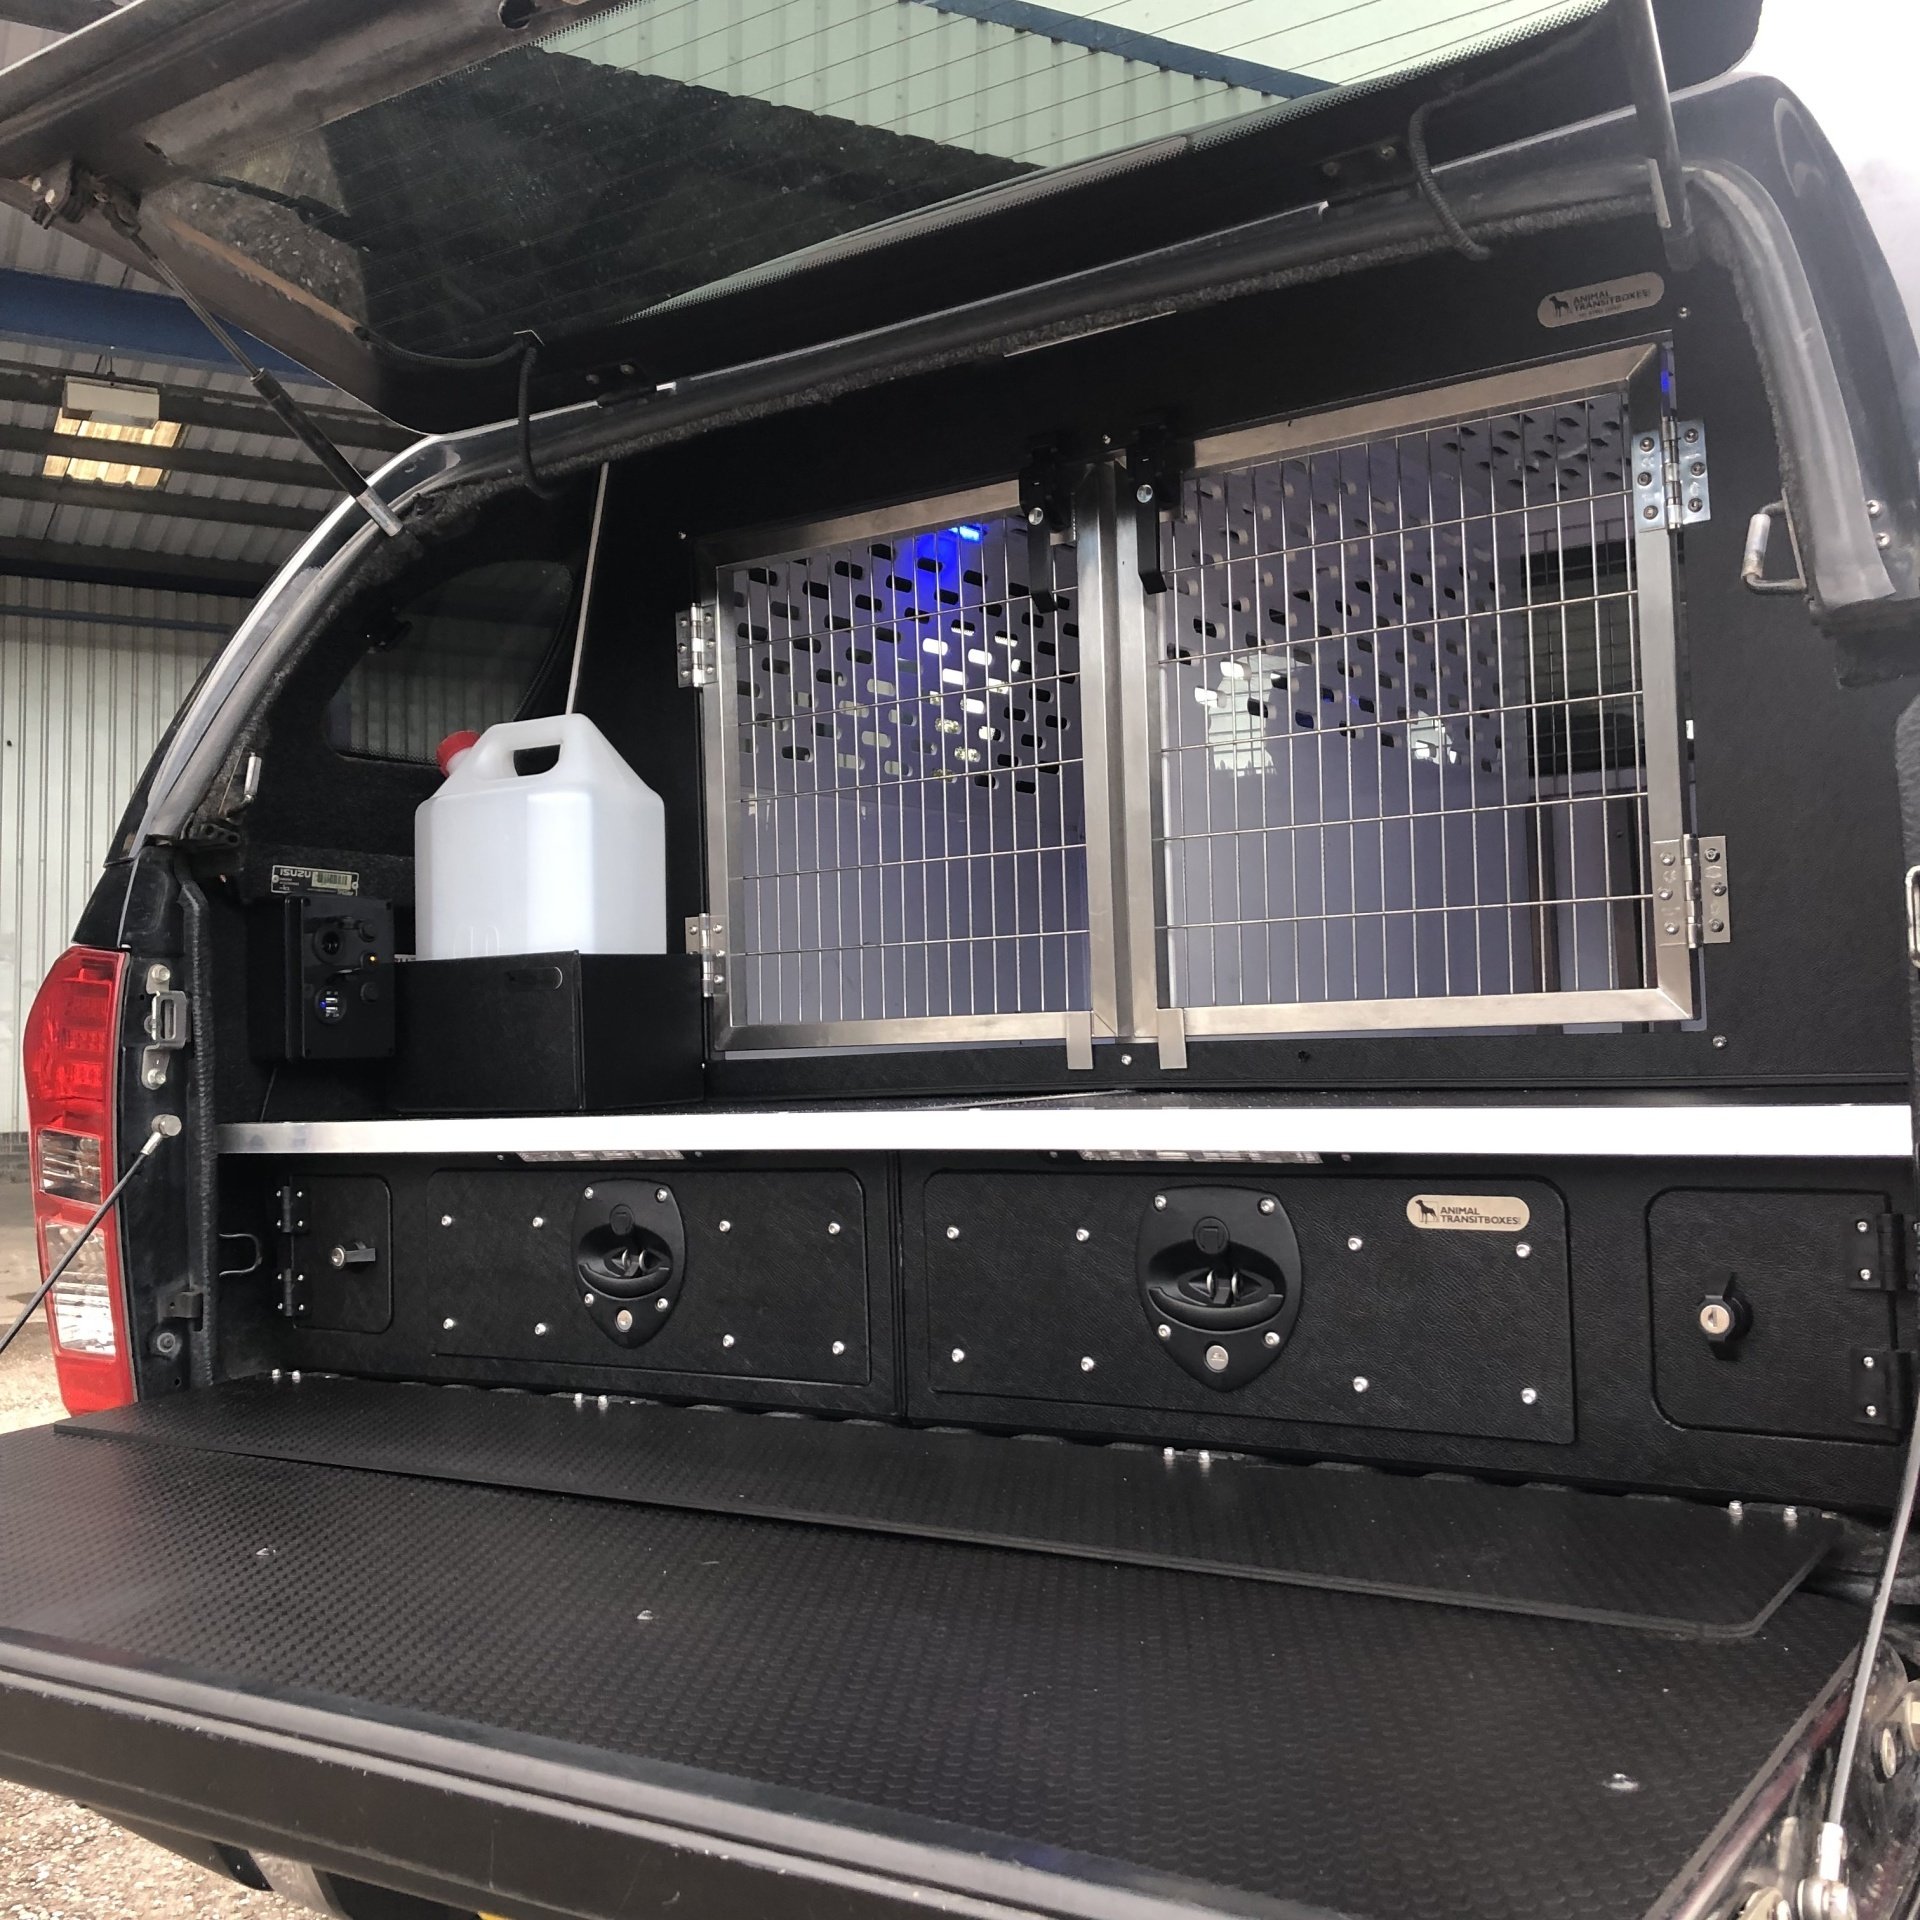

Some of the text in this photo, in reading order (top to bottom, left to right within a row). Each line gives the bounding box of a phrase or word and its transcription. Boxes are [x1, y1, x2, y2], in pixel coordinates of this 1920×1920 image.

[1574, 290, 1609, 304] ANIMAL
[1575, 289, 1649, 311] TRANSITBOXES
[280, 868, 311, 878] ISUZU
[1440, 1206, 1480, 1215] ANIMAL
[1440, 1215, 1519, 1225] TRANSITBOXES
